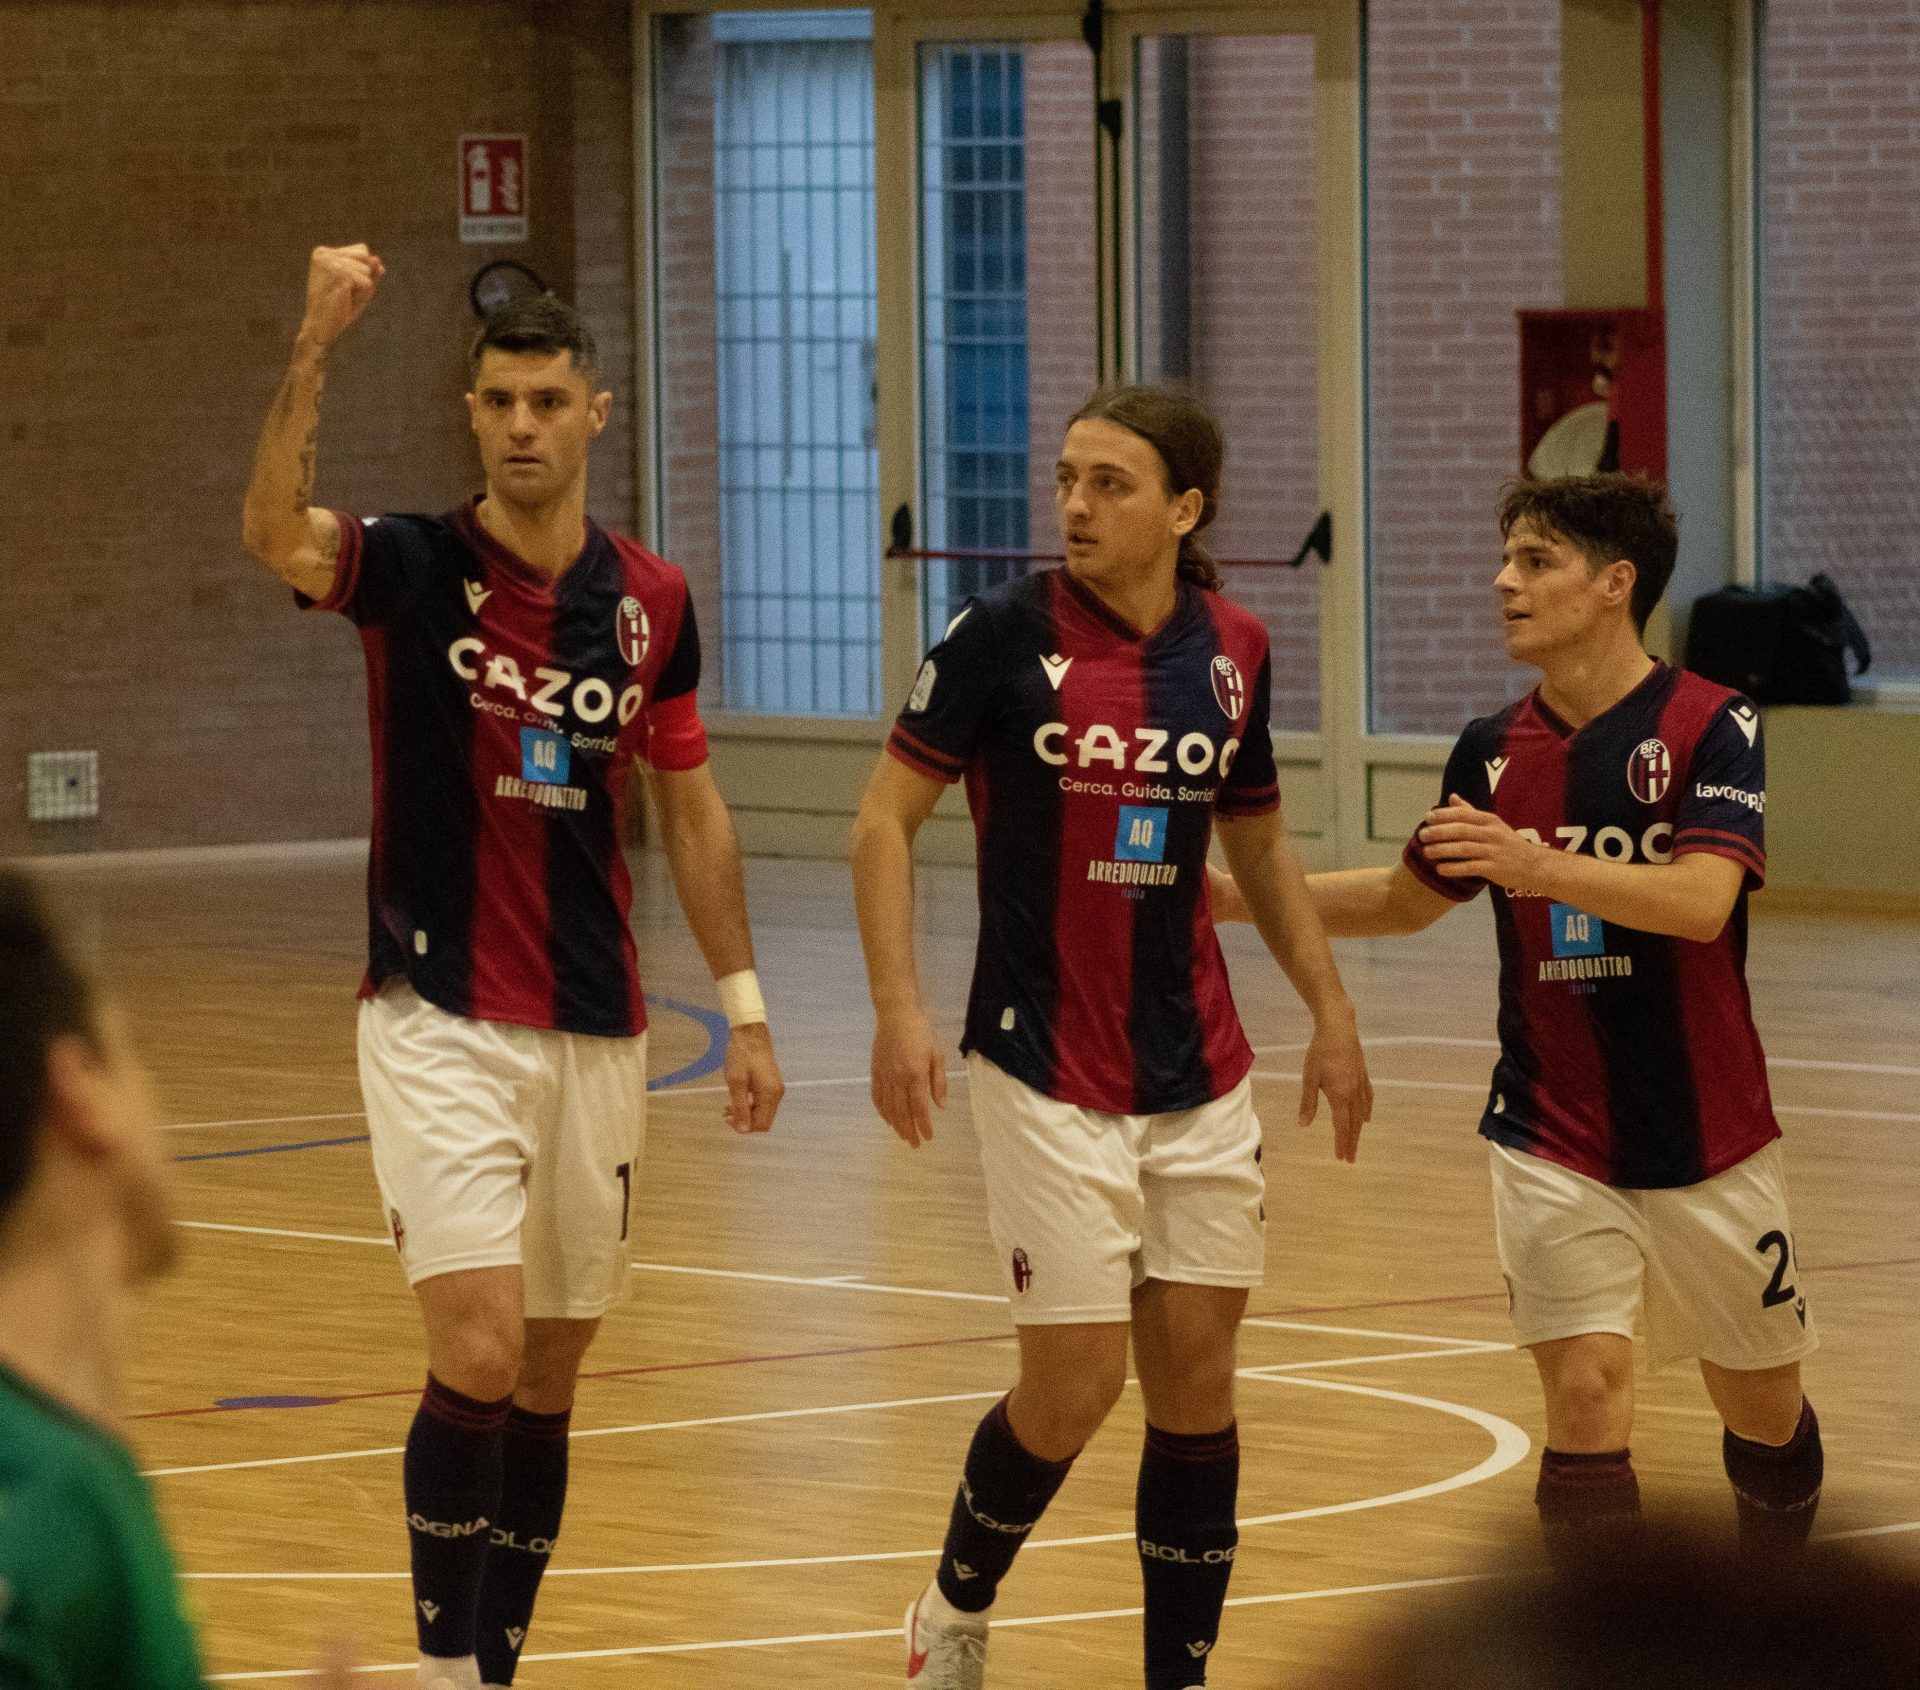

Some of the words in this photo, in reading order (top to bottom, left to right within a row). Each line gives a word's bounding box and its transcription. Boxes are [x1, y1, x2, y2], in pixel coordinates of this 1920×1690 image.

[448, 637, 644, 726] CAZOO
[1640, 741, 1661, 754] BFC
[1059, 776, 1117, 796] Cerca.
[1121, 782, 1174, 801] Guida.
[1128, 818, 1154, 848] AQ
[1565, 914, 1589, 943] AQ
